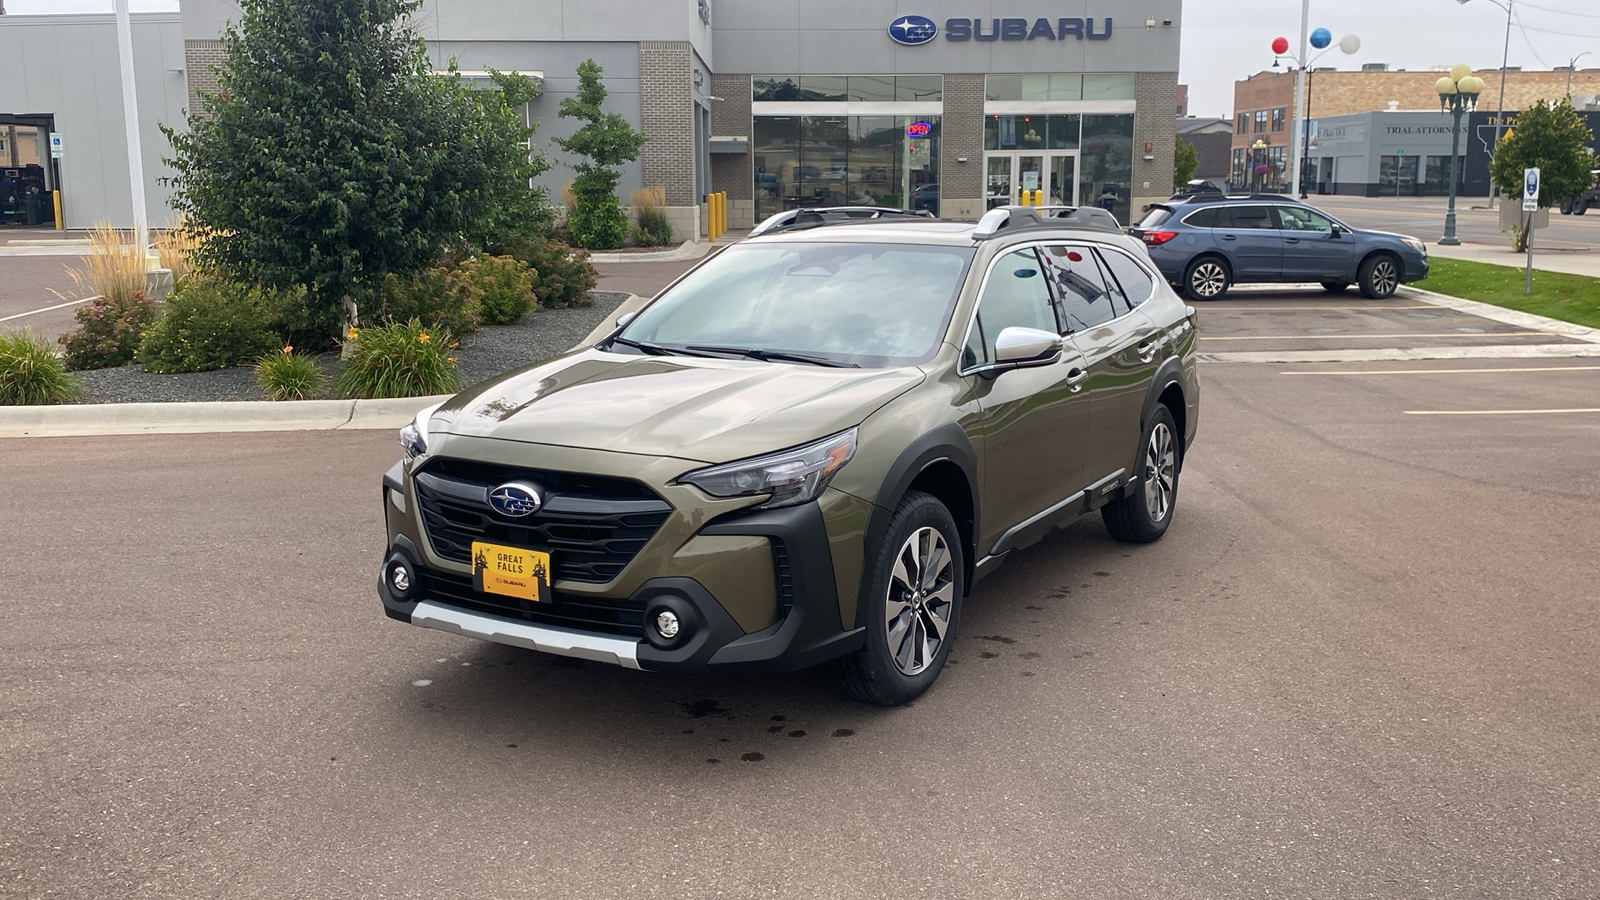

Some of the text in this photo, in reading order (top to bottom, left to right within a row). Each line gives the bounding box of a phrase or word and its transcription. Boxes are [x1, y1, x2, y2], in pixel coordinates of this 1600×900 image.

[945, 18, 1113, 41] SUBARU
[907, 124, 929, 134] OPEN
[1386, 126, 1414, 134] TRIAL
[497, 553, 524, 565] GREAT
[497, 562, 524, 574] FALLS
[503, 579, 527, 588] SUBARU
